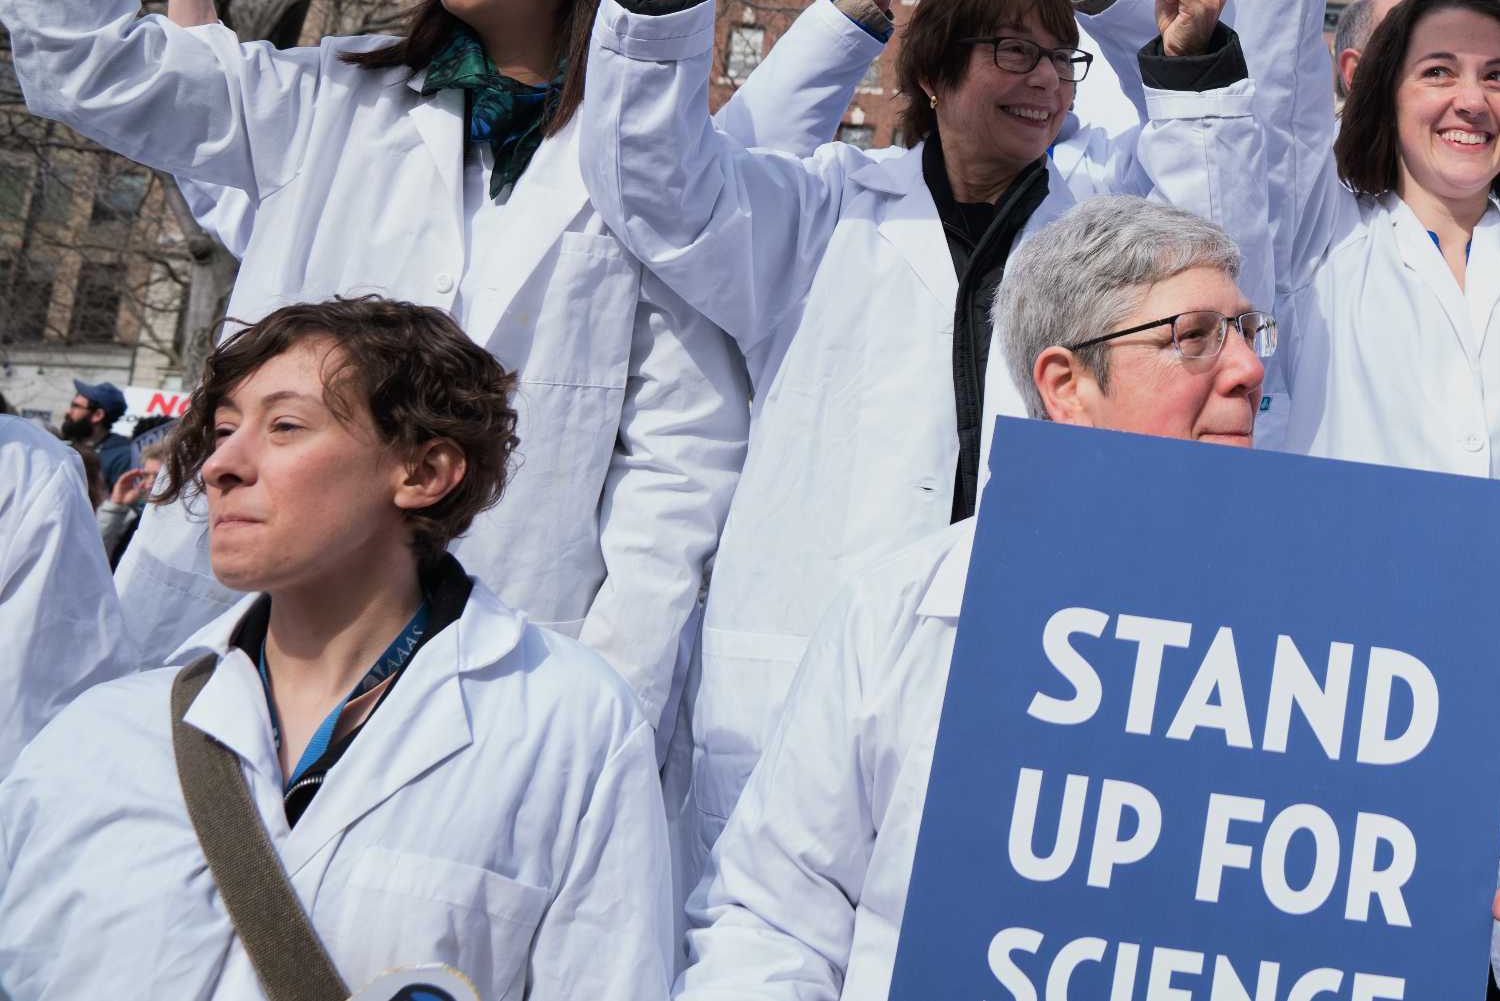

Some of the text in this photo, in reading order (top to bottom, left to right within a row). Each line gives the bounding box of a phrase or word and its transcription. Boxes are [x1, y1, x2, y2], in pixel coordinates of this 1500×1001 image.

[1026, 606, 1440, 766] STAND
[1007, 766, 1418, 928] UP FOR
